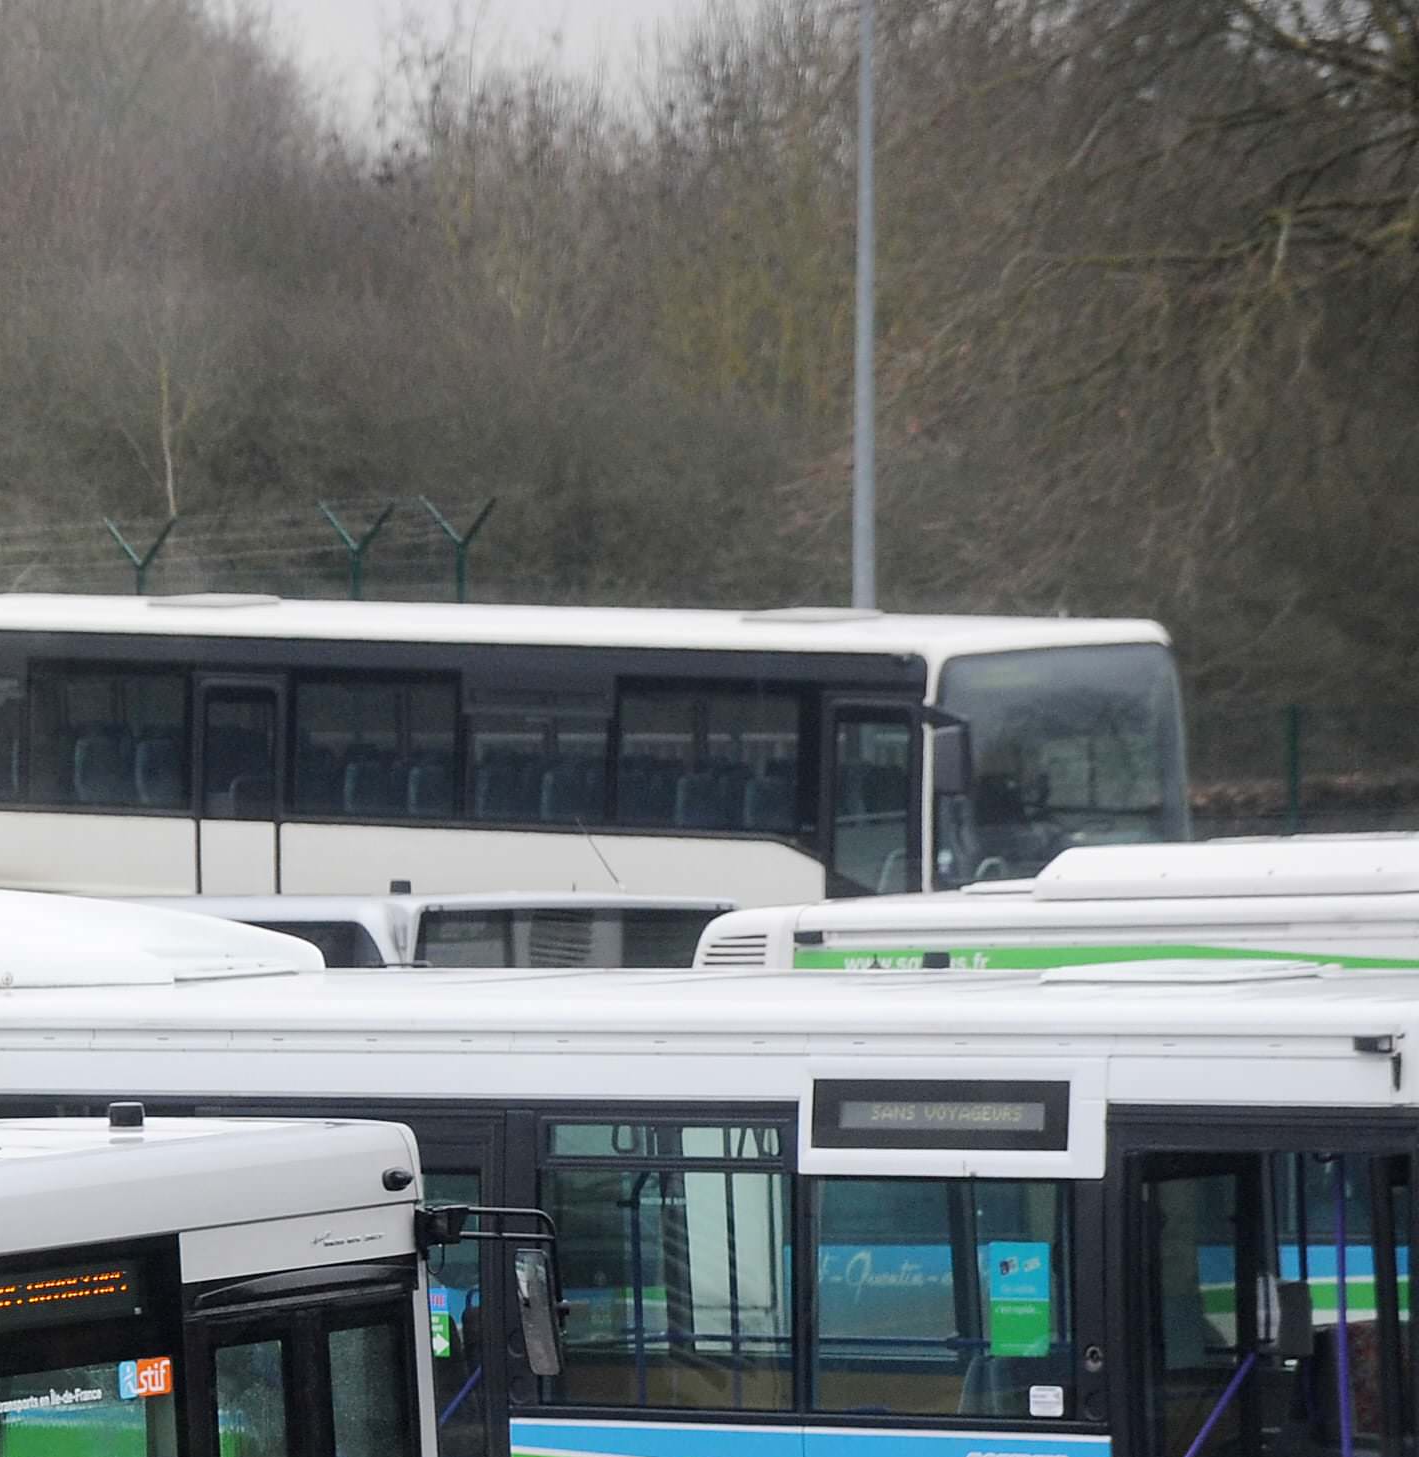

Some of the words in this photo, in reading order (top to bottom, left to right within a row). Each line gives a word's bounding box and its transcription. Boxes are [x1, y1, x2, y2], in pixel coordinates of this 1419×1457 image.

[844, 952, 990, 969] www.sqs.fr
[871, 1105, 915, 1121] SANS
[923, 1105, 1025, 1121] VOYAGEURS
[137, 1359, 172, 1394] stif
